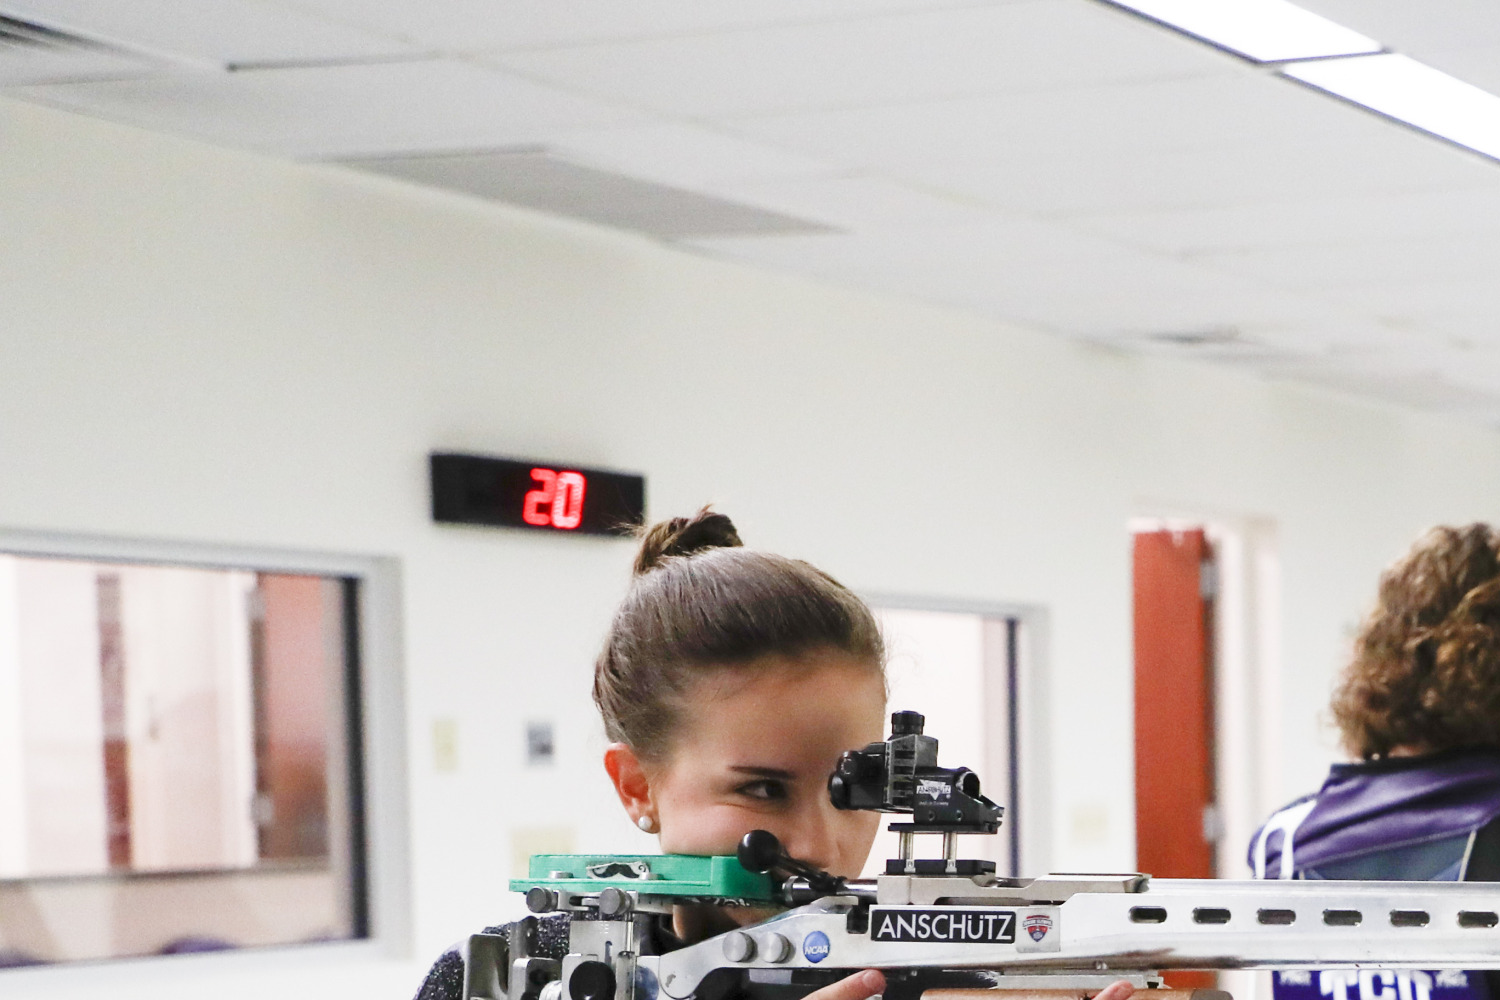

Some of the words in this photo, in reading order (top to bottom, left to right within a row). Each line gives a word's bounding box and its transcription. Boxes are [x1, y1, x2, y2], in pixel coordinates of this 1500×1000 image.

[522, 467, 587, 529] 20
[876, 913, 1013, 941] ANSCHÜTZ
[804, 945, 829, 955] NCAA
